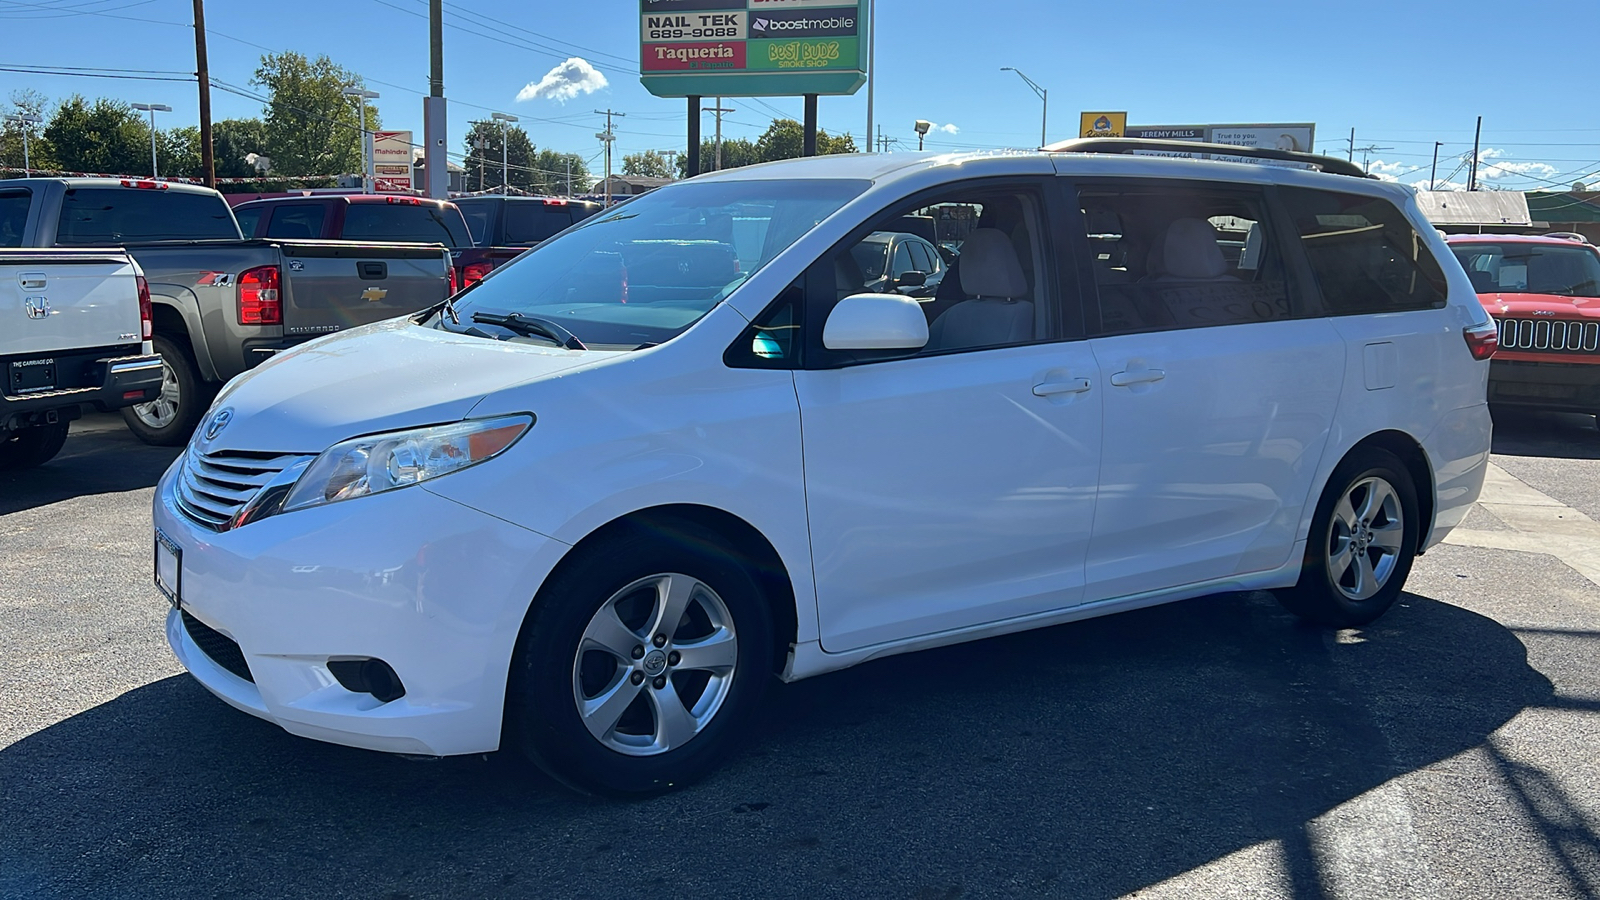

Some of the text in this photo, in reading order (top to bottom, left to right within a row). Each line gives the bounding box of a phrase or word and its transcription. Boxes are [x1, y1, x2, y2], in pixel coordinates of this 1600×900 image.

[648, 14, 738, 28] NAIL TEK
[650, 28, 737, 39] 689-9088
[655, 43, 734, 62] Taquería
[778, 60, 828, 68] SMOKE SHOP
[290, 325, 340, 333] SILVERADO
